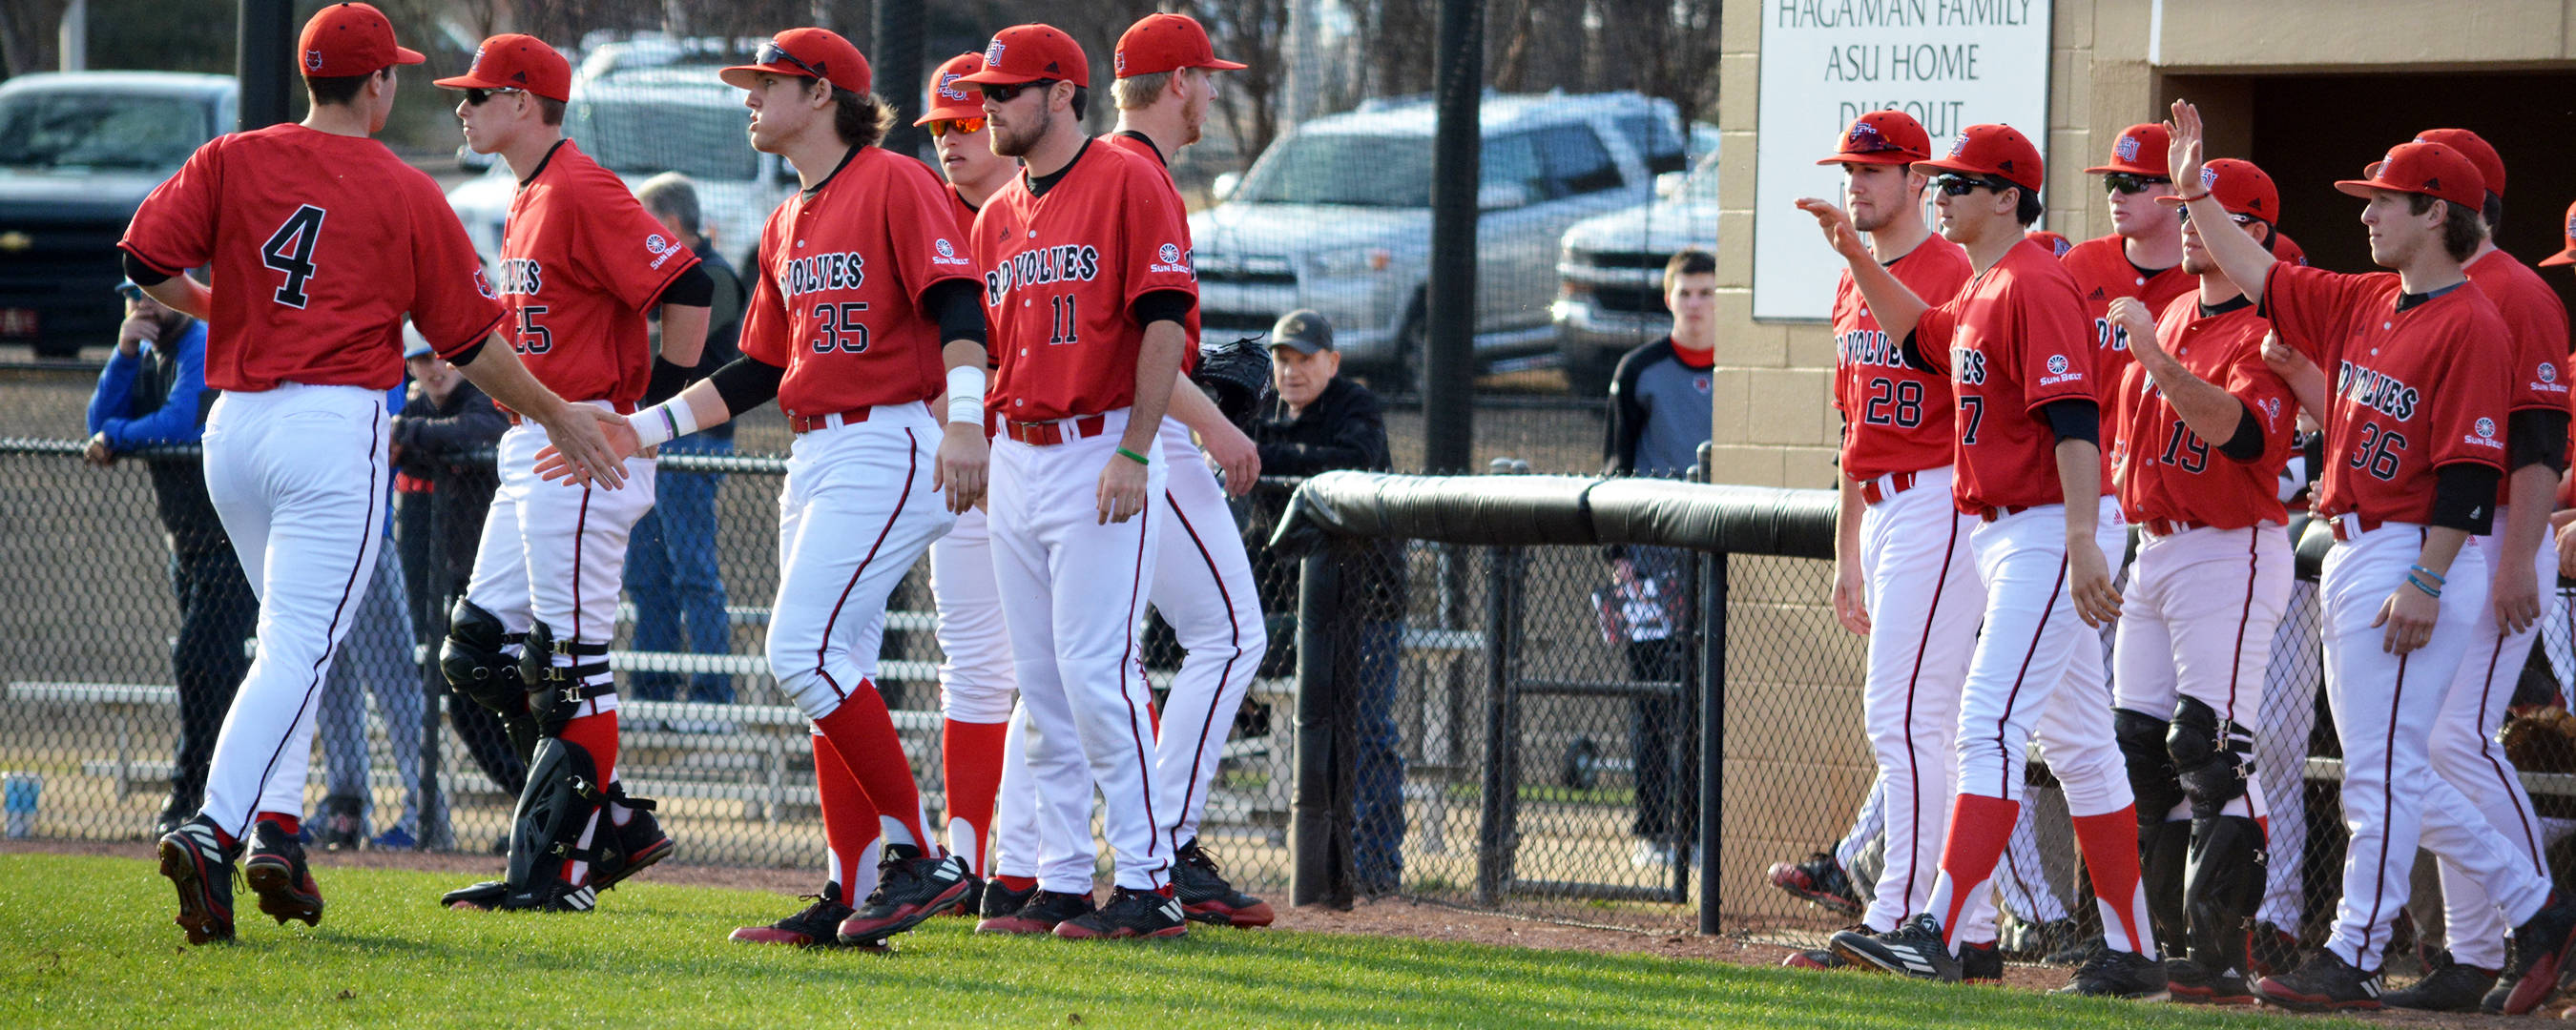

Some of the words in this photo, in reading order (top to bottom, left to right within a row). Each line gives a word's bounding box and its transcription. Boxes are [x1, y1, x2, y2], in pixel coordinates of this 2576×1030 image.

[1778, 0, 1926, 28] HAGAMAN
[1938, 0, 2032, 27] FAMILY
[1824, 45, 1880, 82] ASU
[1891, 44, 1980, 81] HOME
[1839, 101, 1964, 138] DOUT
[260, 203, 326, 310] 4
[1151, 263, 1172, 273] SUN
[813, 301, 869, 354] 35
[1049, 294, 1078, 345] 11
[1847, 329, 1916, 370] OLVE
[1864, 378, 1924, 429] 28
[2040, 377, 2061, 386] SUN
[2060, 373, 2082, 381] BELT
[1961, 395, 1984, 445] 7
[2160, 420, 2211, 475] 19
[2350, 422, 2408, 482] 36
